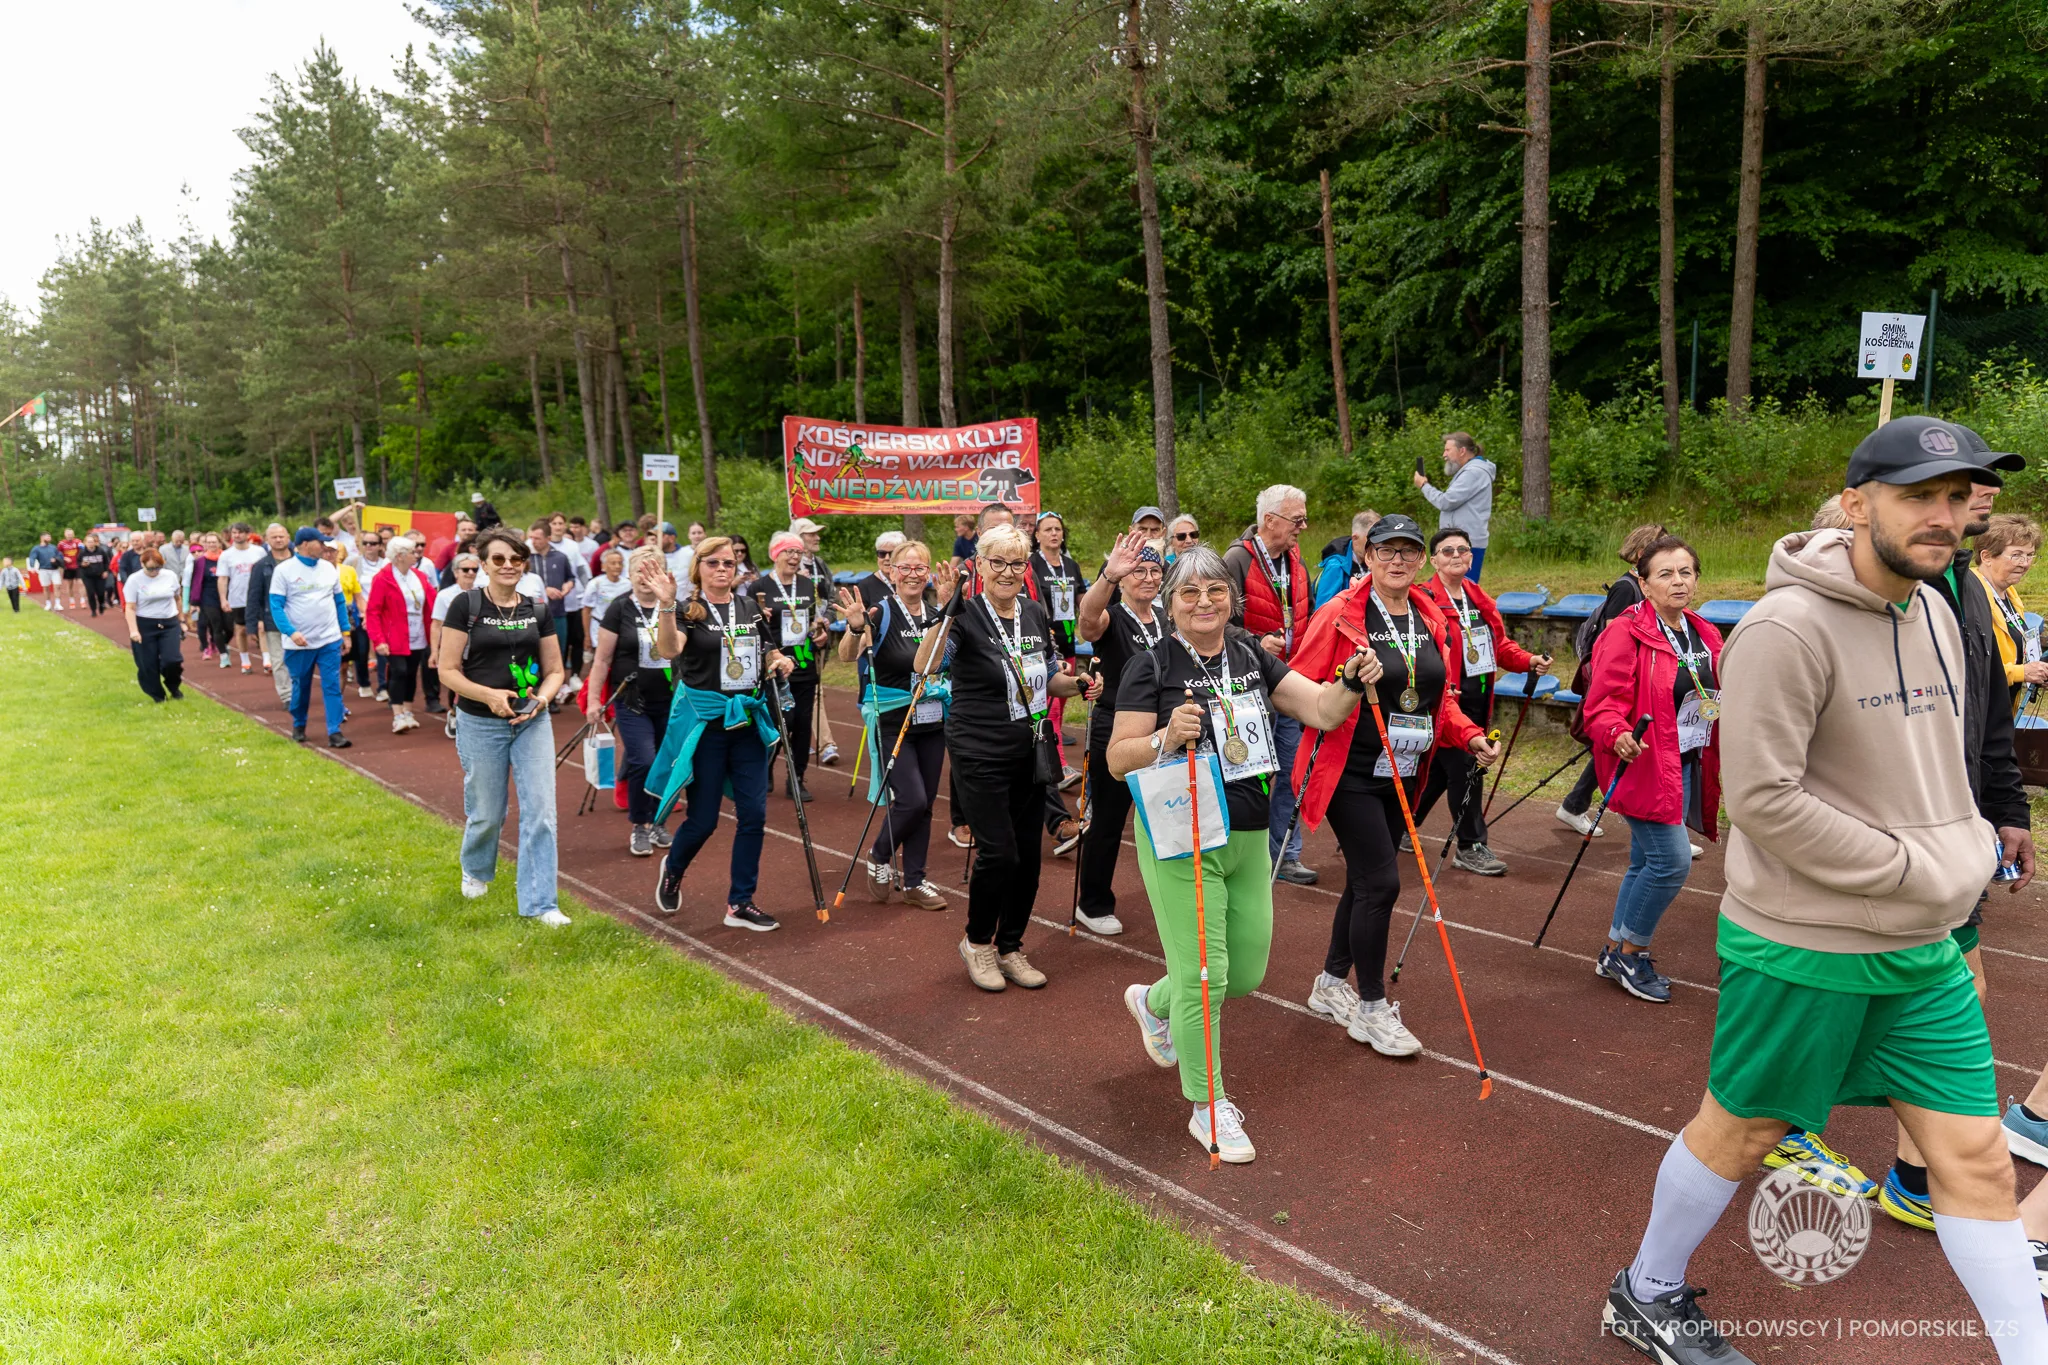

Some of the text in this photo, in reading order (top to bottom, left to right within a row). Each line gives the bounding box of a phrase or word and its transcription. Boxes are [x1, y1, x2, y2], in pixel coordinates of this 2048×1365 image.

[1881, 323, 1906, 333] GMINA
[1865, 336, 1915, 349] KOŚCIERZYNA
[799, 423, 1022, 451] KOŚCIERSKI KLUB
[908, 450, 1021, 472] WALKING
[809, 475, 1009, 500] "NIEDŹWIEDŹ"
[1183, 670, 1260, 688] Kośiezyna
[1858, 689, 1909, 709] TOMM
